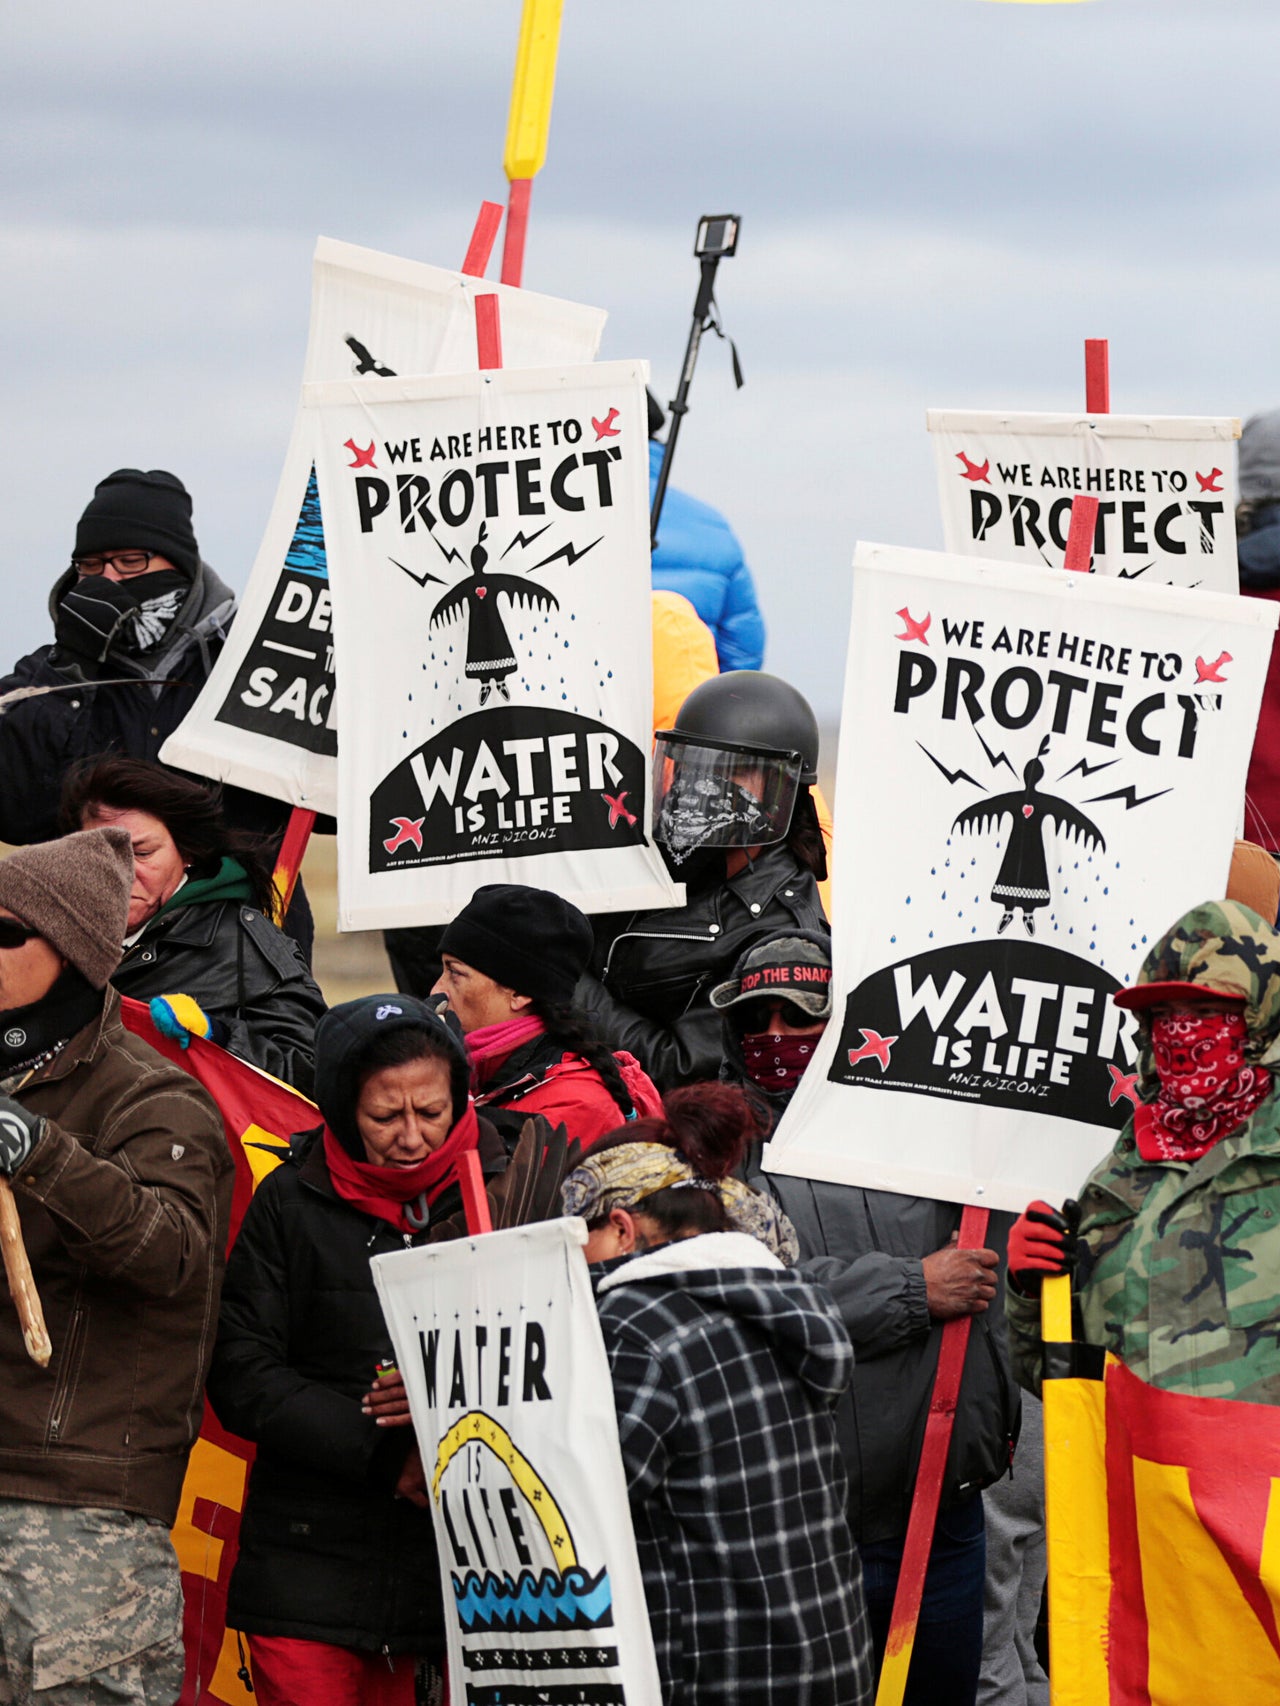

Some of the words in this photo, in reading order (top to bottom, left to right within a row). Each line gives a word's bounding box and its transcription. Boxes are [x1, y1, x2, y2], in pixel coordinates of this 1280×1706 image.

[384, 438, 423, 464] WE
[430, 432, 472, 461] ARE
[478, 424, 541, 453] HERE
[547, 418, 582, 445] TO
[355, 446, 622, 533] PROTECT
[997, 463, 1033, 487] WE
[1040, 466, 1082, 490] ARE
[1087, 467, 1146, 492] HERE
[1152, 470, 1187, 494] TO
[942, 618, 984, 648] WE
[991, 625, 1051, 658] ARE
[1057, 632, 1132, 675] HERE
[1140, 651, 1183, 682] TO
[894, 650, 1222, 759] PROTECT
[409, 732, 624, 812] WATER
[454, 803, 486, 834] IS
[497, 795, 572, 829] LIFE
[471, 833, 499, 845] MNI
[762, 967, 790, 984] THE
[893, 964, 1140, 1067] WATER
[932, 1035, 972, 1068] IS
[982, 1042, 1073, 1086] LIFE
[948, 1072, 981, 1086] MNI
[982, 1076, 1051, 1097] WICONI
[418, 1321, 552, 1409] WATER
[467, 1445, 481, 1483] IS
[441, 1487, 533, 1568] LIFE
